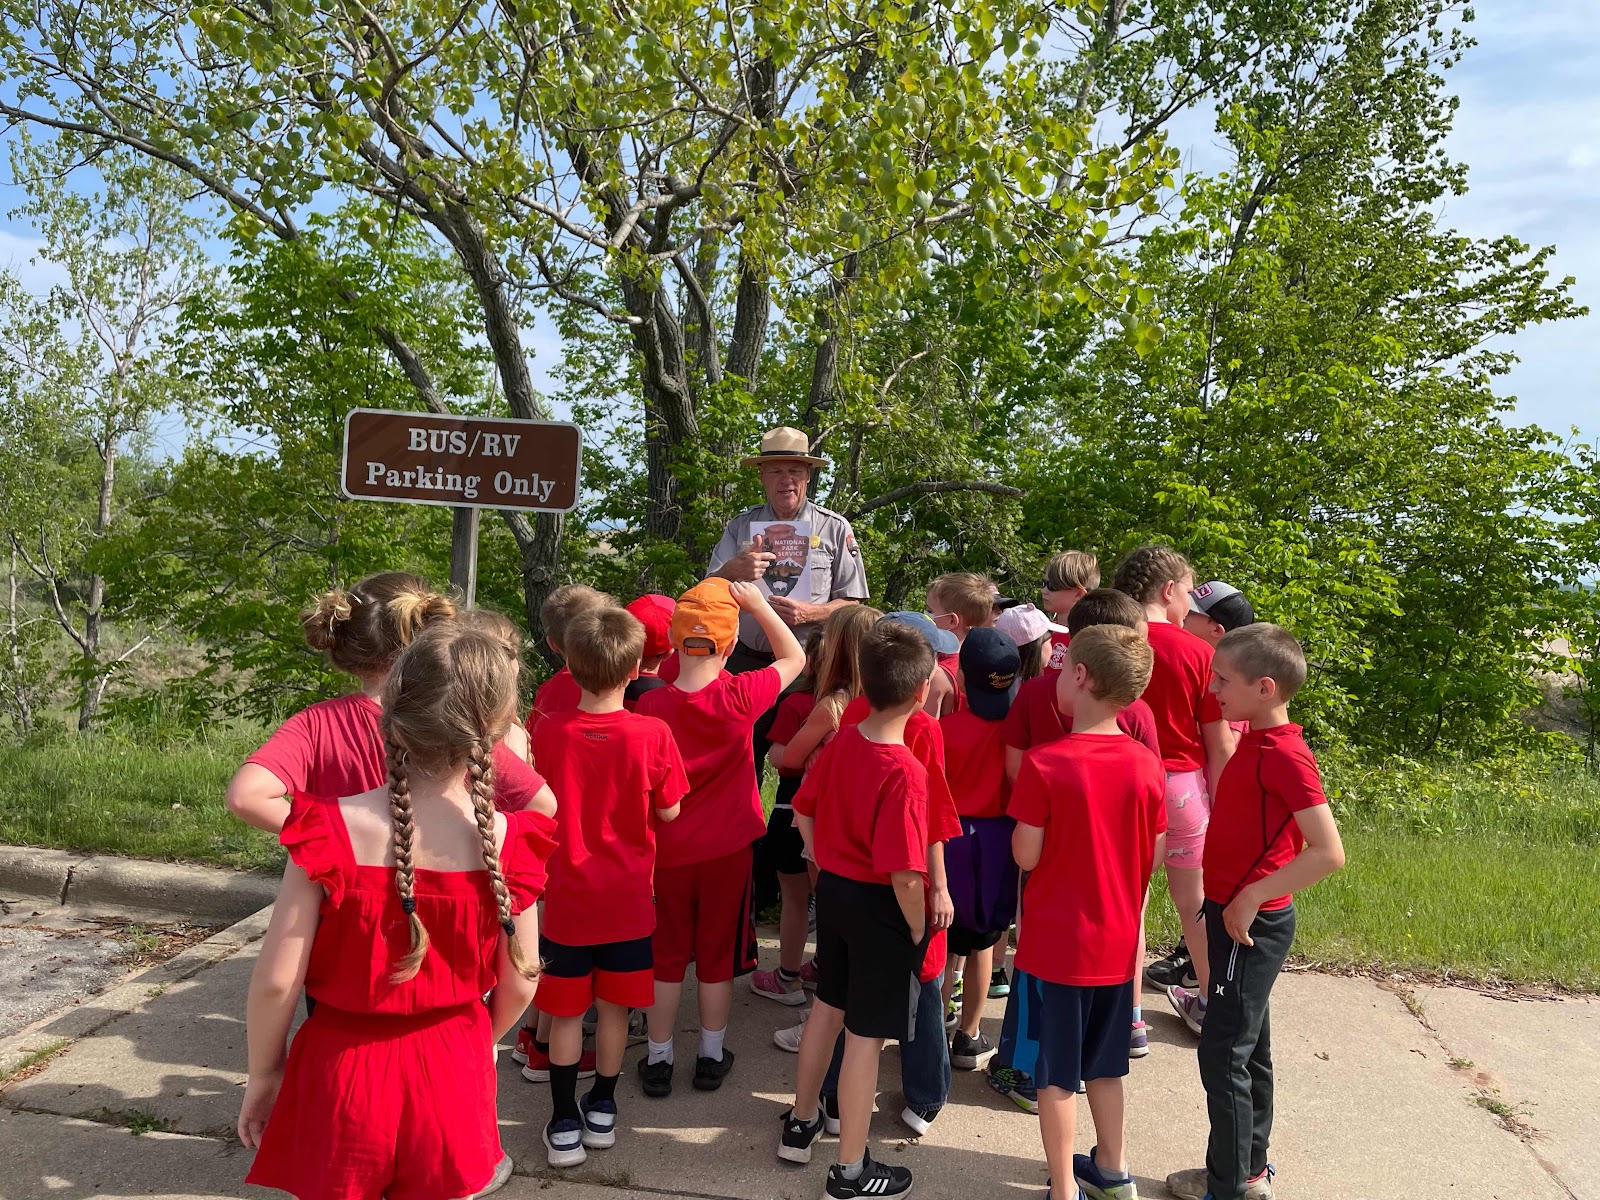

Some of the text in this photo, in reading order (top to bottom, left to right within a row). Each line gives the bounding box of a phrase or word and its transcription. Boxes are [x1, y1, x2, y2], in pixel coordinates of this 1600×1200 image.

[408, 428, 521, 457] BUS/RV
[365, 461, 556, 502] Parking Only
